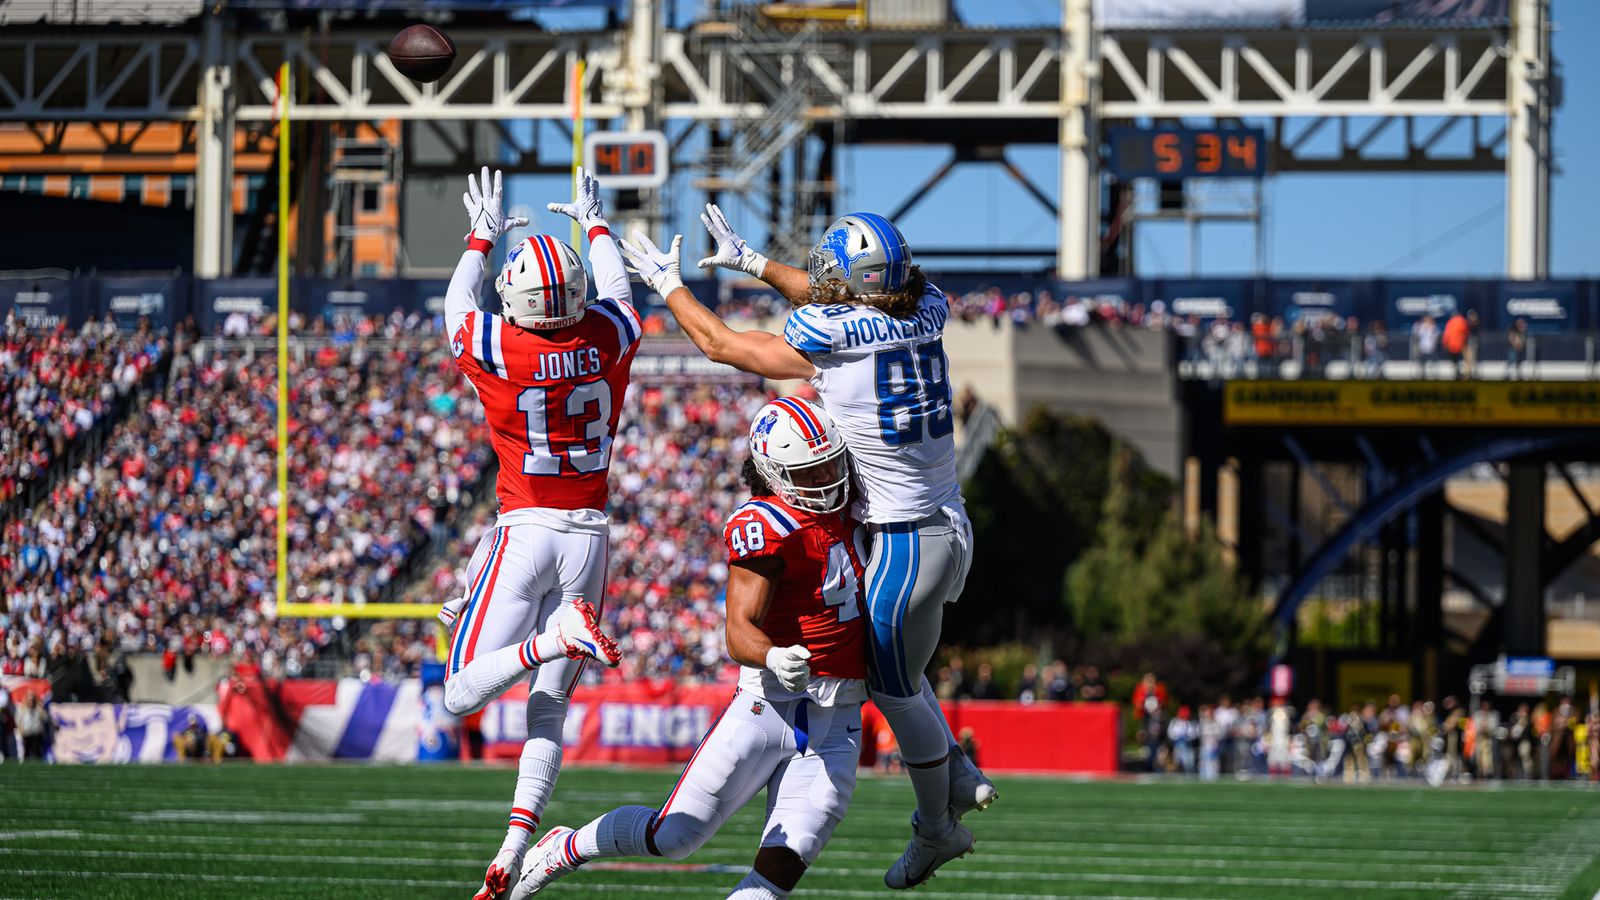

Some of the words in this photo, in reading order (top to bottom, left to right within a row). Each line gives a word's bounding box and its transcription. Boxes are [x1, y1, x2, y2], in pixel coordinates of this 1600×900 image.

[595, 143, 654, 176] 40
[534, 316, 577, 329] PATRIOTS
[534, 346, 602, 382] JONES
[874, 340, 954, 447] 88
[516, 378, 614, 476] 13
[731, 521, 765, 558] 48
[822, 525, 868, 623] 4
